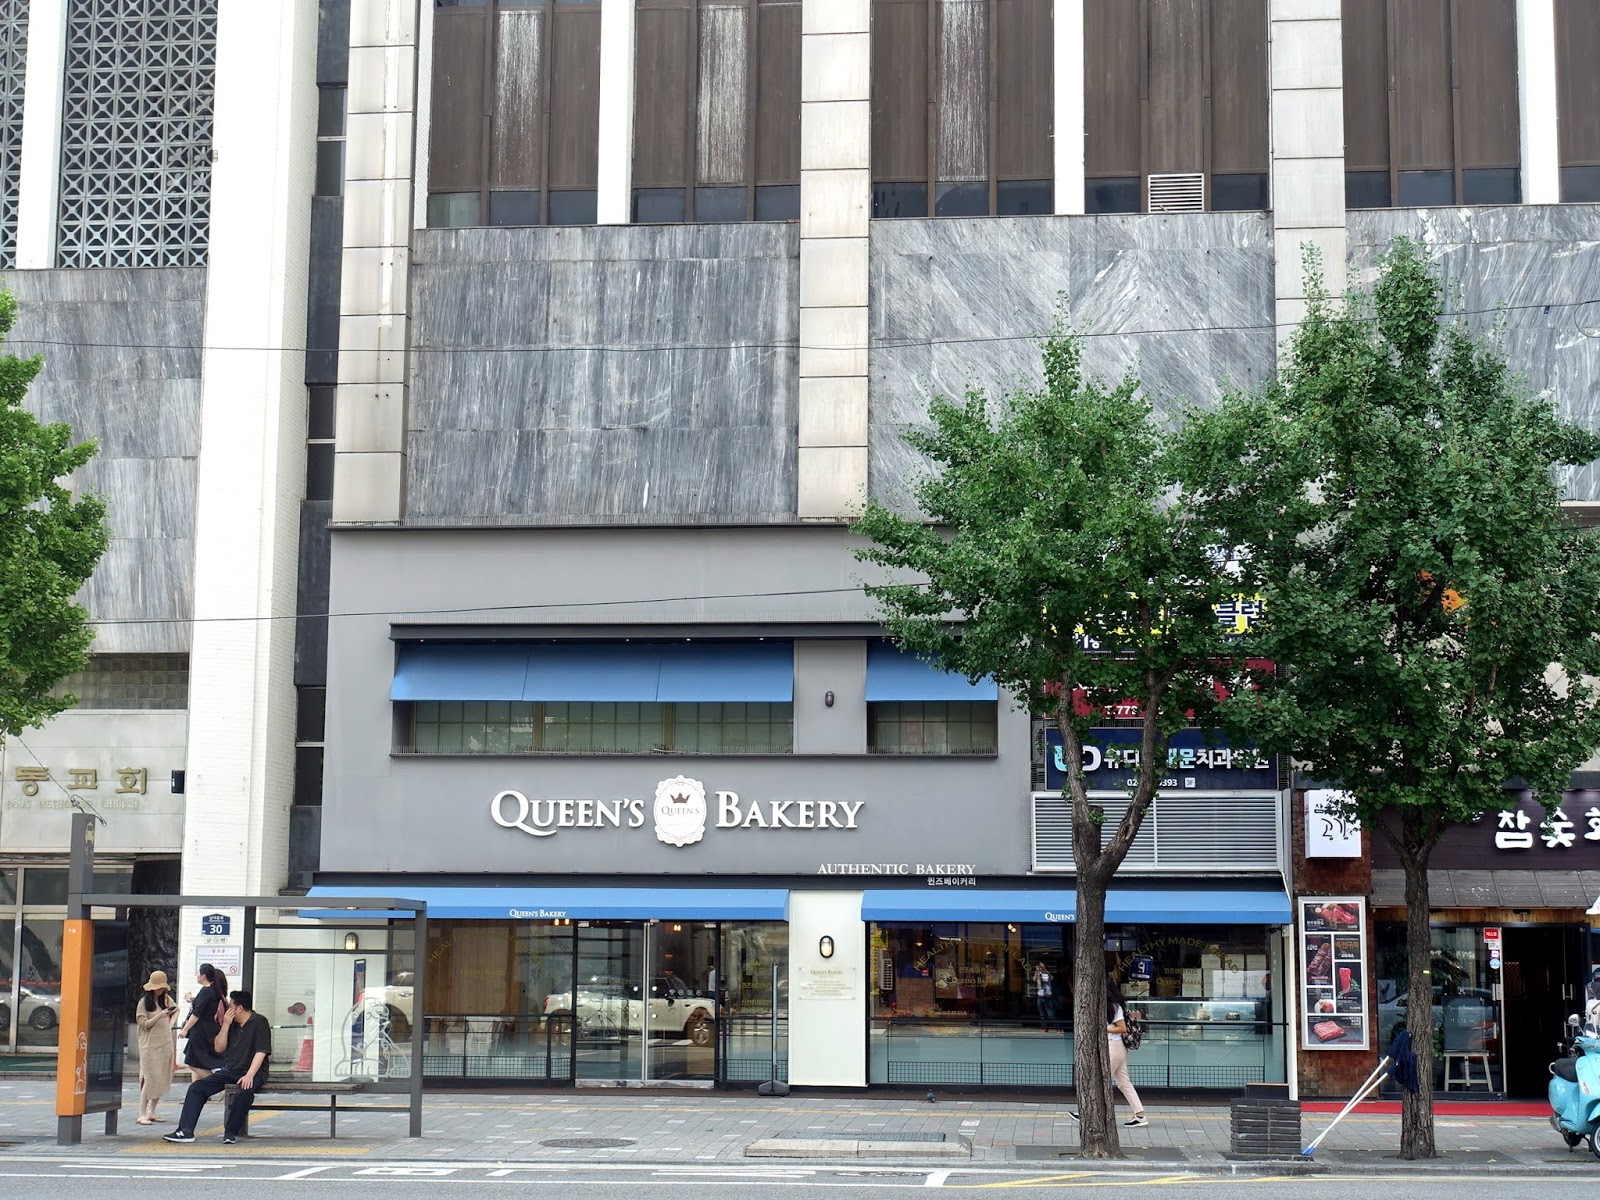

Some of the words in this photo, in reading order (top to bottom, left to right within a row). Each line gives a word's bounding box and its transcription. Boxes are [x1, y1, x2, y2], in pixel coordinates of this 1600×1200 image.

[490, 789, 646, 836] QUEEN'S
[715, 790, 865, 829] BAKERY
[817, 863, 909, 875] AUTHENTIC
[915, 864, 976, 875] BAKERY
[927, 877, 976, 886] 퀸즈베이커리
[509, 908, 538, 919] QUEEN'S
[539, 909, 567, 918] BAKERY
[209, 924, 223, 934] 30
